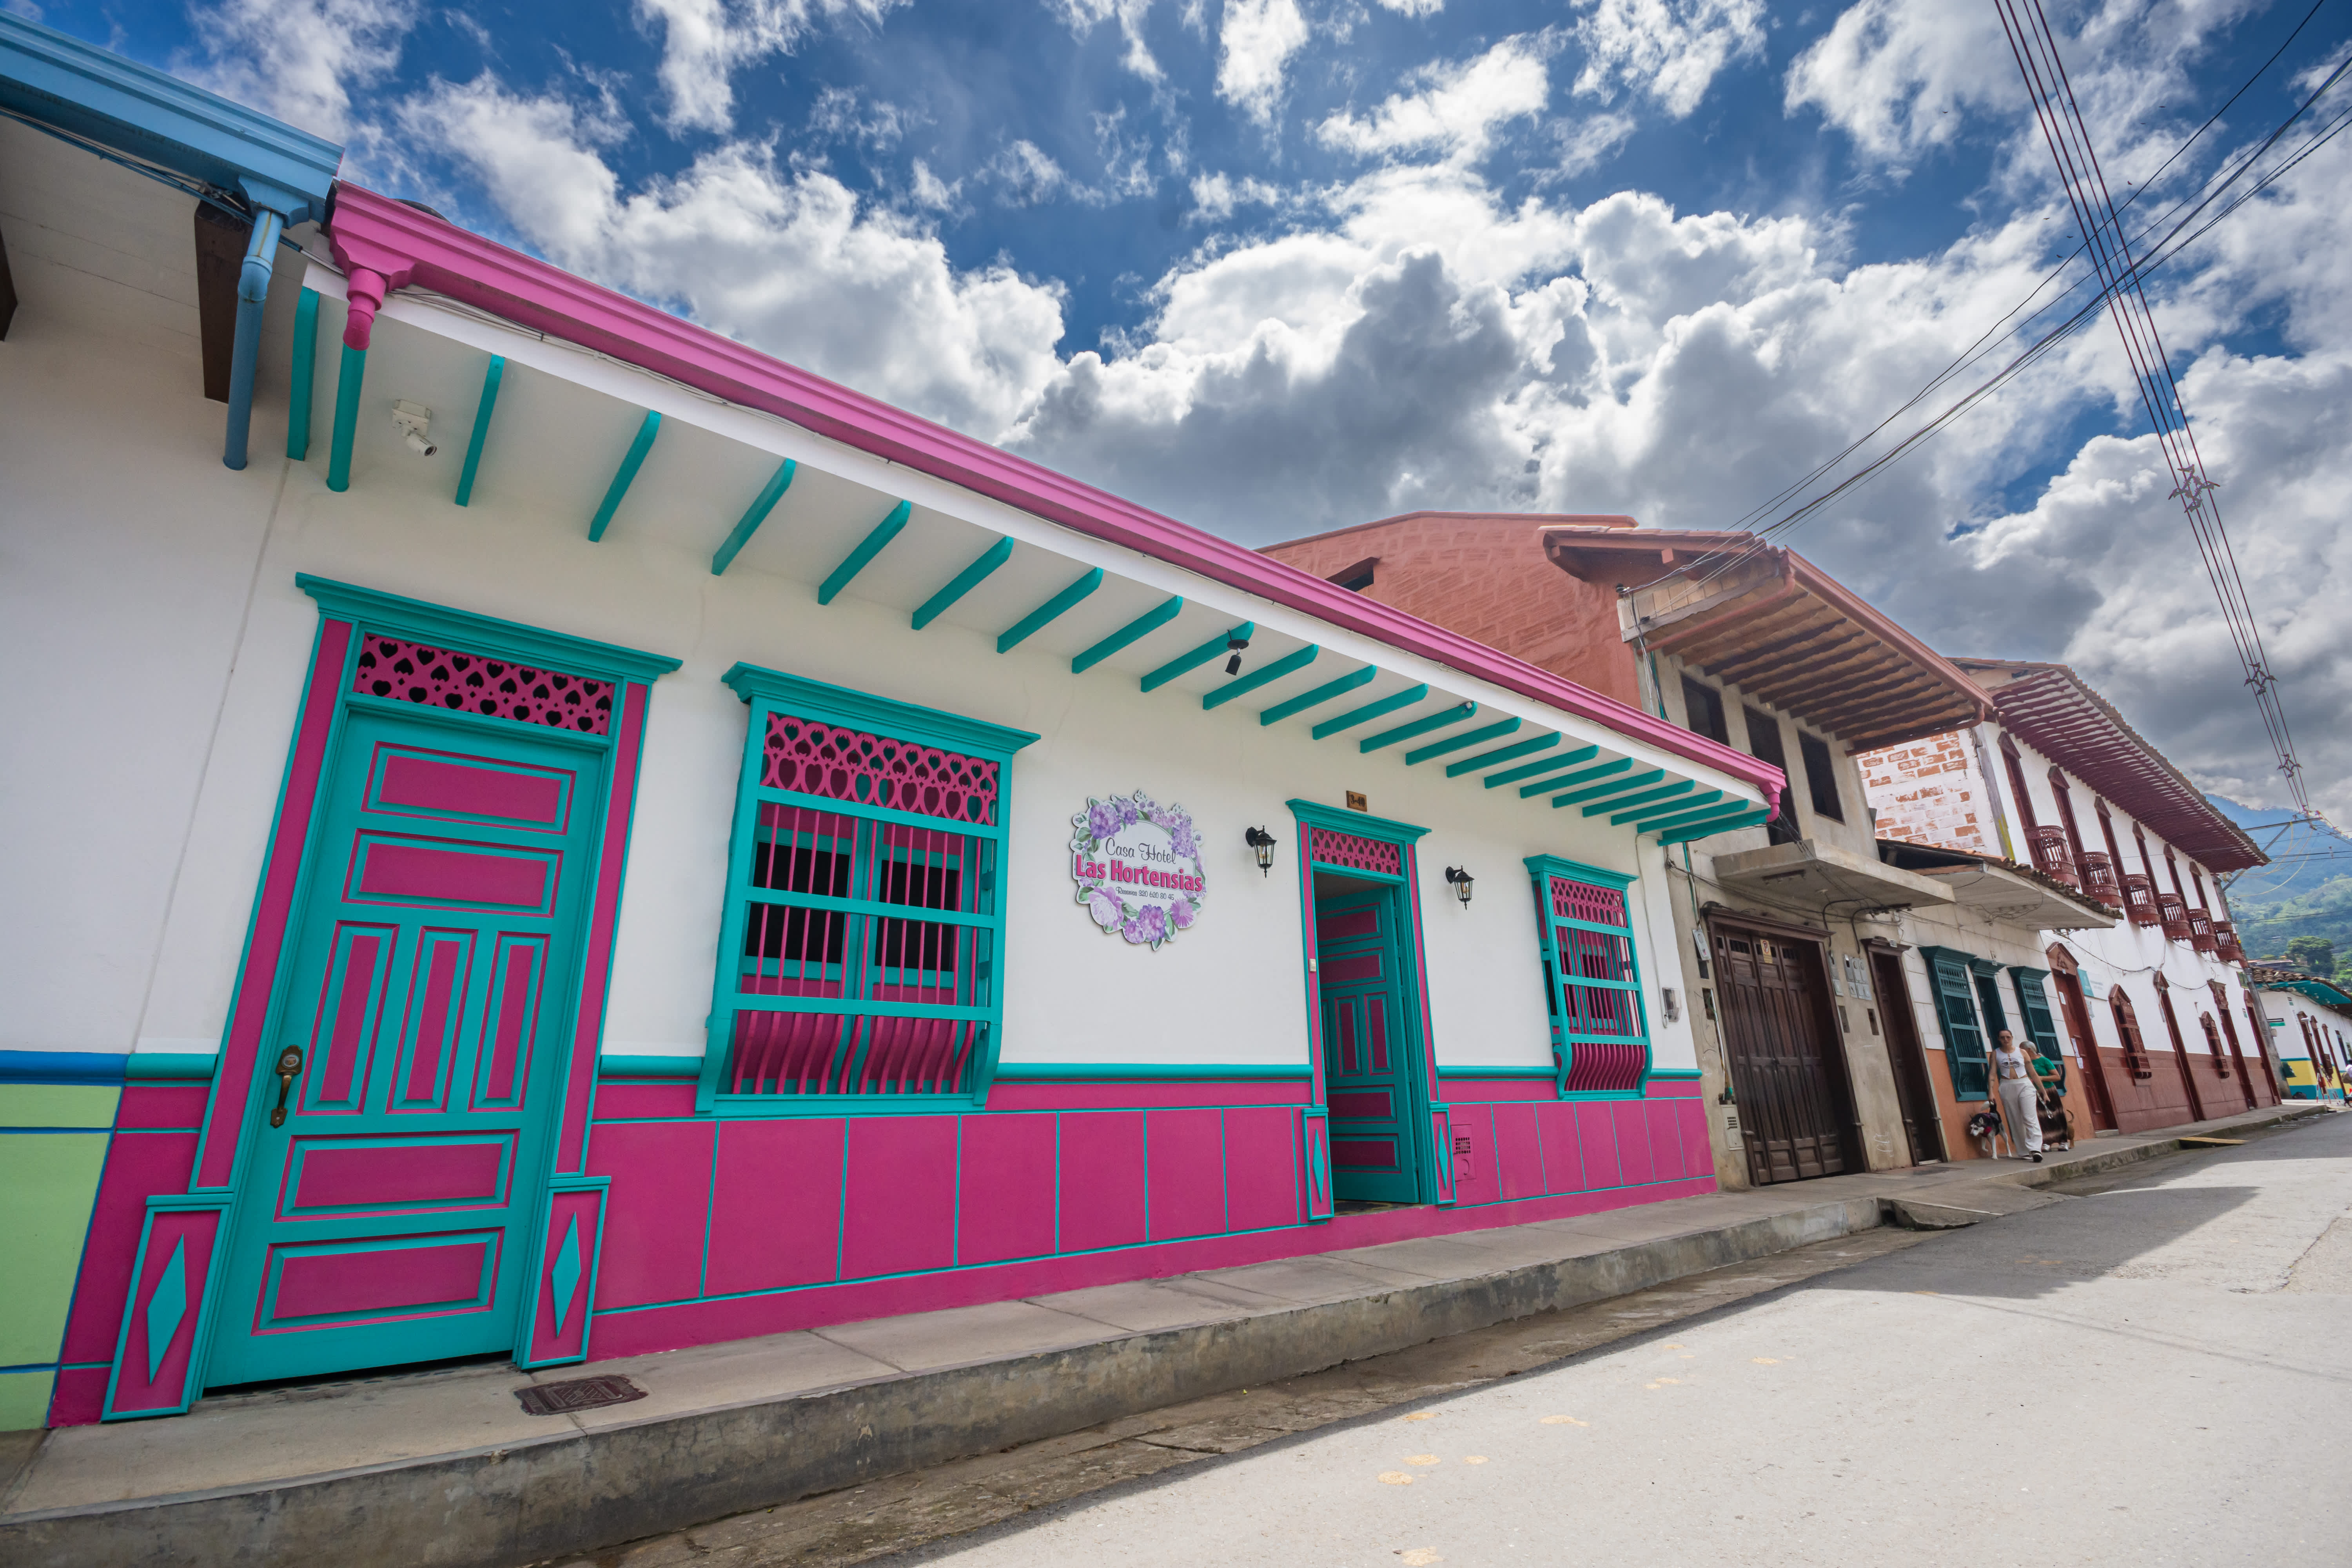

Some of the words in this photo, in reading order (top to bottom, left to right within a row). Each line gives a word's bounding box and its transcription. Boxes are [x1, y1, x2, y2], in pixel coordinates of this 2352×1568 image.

[1105, 837, 1134, 858] Casa
[1138, 843, 1176, 864] Hotel
[1076, 855, 1106, 879] Las
[1111, 859, 1203, 892] Hortensias
[1116, 887, 1137, 896] Reservas
